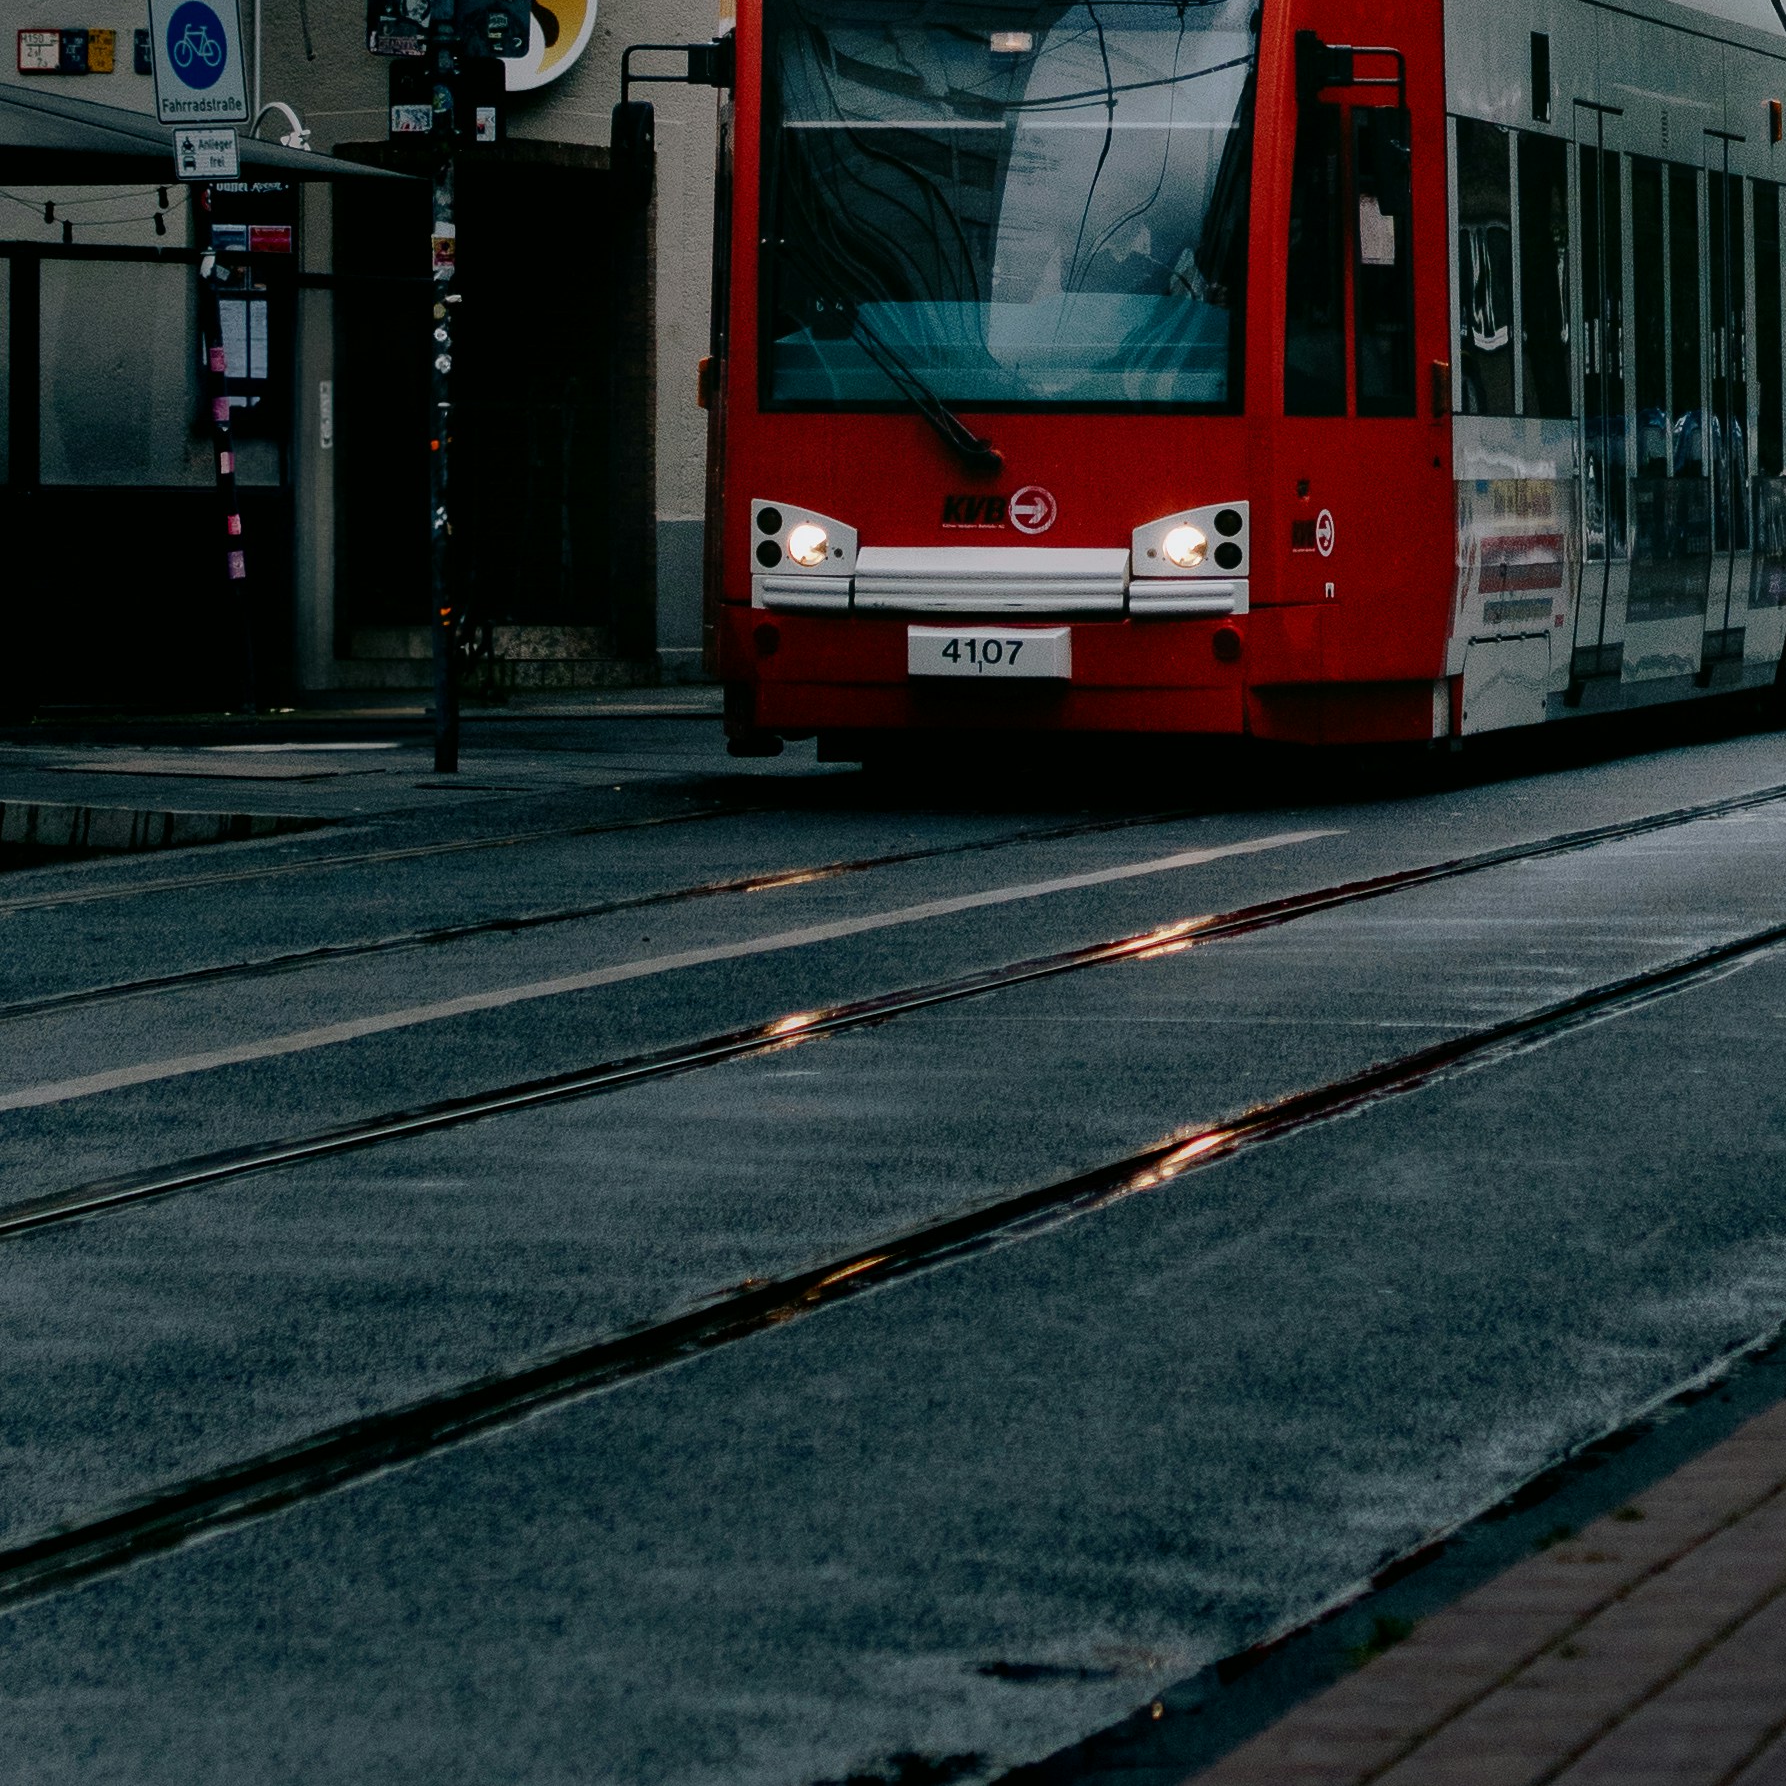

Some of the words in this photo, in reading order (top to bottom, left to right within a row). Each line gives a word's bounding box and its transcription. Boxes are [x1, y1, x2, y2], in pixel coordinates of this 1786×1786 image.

[162, 96, 242, 113] Fahrradstraße
[198, 138, 233, 152] Anlieger
[209, 156, 225, 168] frei
[943, 495, 1007, 523] KVB
[942, 638, 1024, 665] 4107
